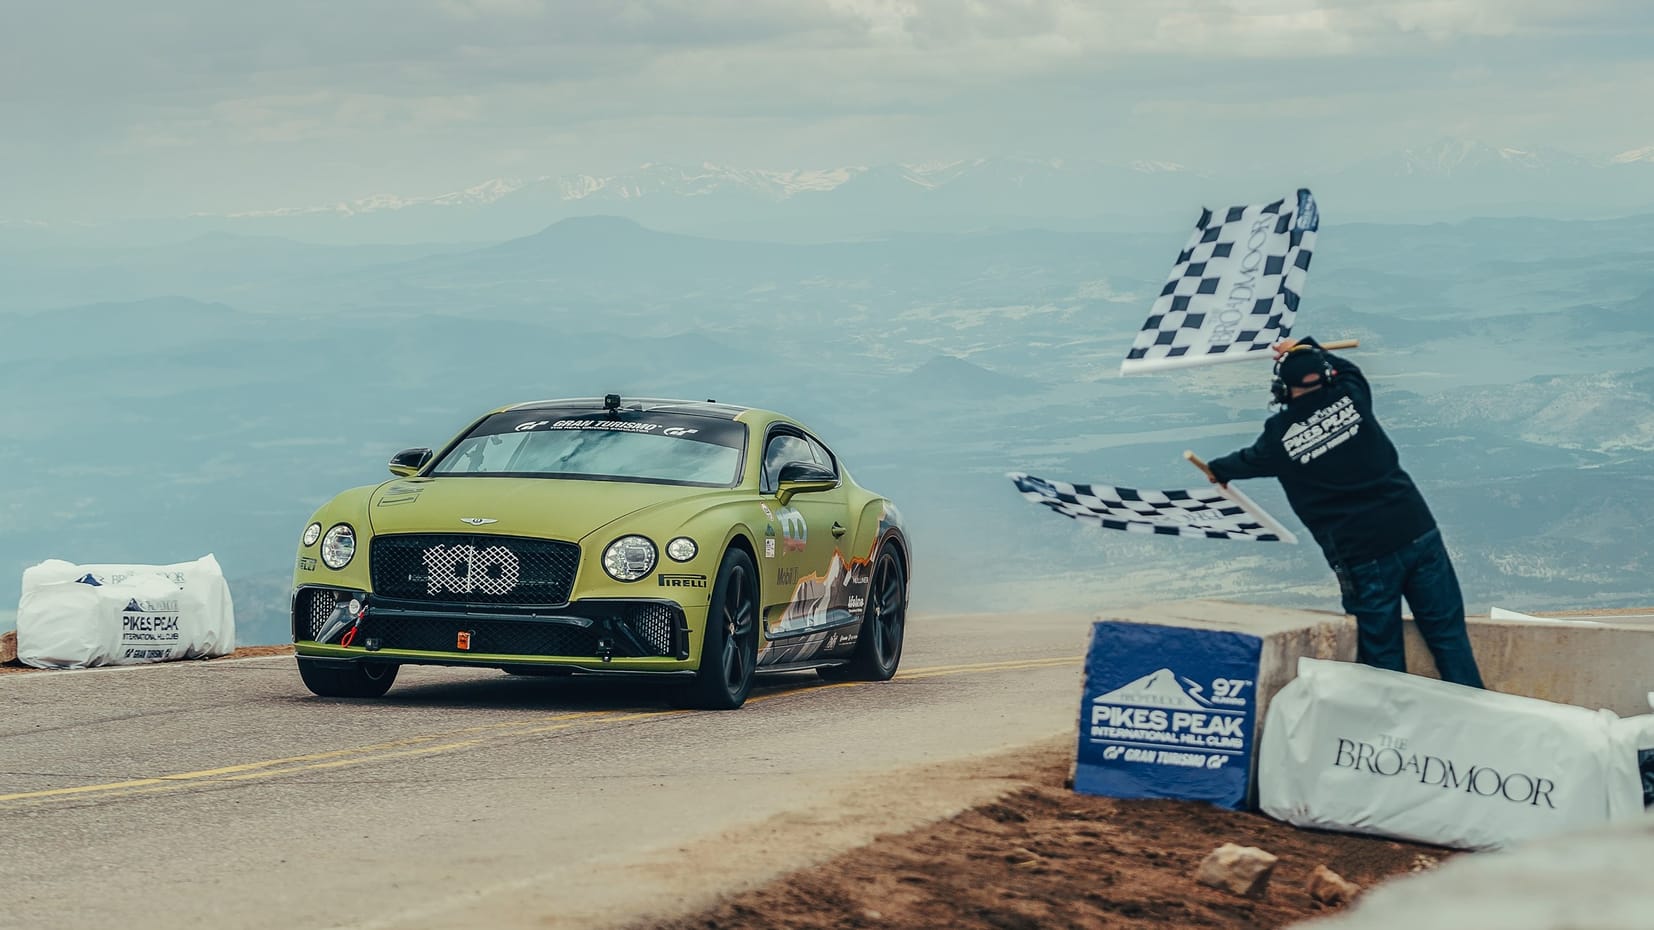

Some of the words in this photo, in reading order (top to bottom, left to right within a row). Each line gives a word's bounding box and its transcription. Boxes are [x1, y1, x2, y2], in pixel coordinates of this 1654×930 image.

[595, 420, 657, 431] TURISMO
[658, 574, 707, 588] PIRELLI
[123, 616, 152, 631] PIKES
[154, 616, 179, 631] PEAK
[1091, 705, 1169, 731] PIKES
[1172, 712, 1244, 738] PEAK
[1090, 726, 1179, 743] INTERNATIONAL
[1180, 733, 1205, 746] HILL
[1205, 735, 1244, 749] CLIMB
[1378, 733, 1408, 751] THE
[1334, 737, 1556, 809] BROADMOOR
